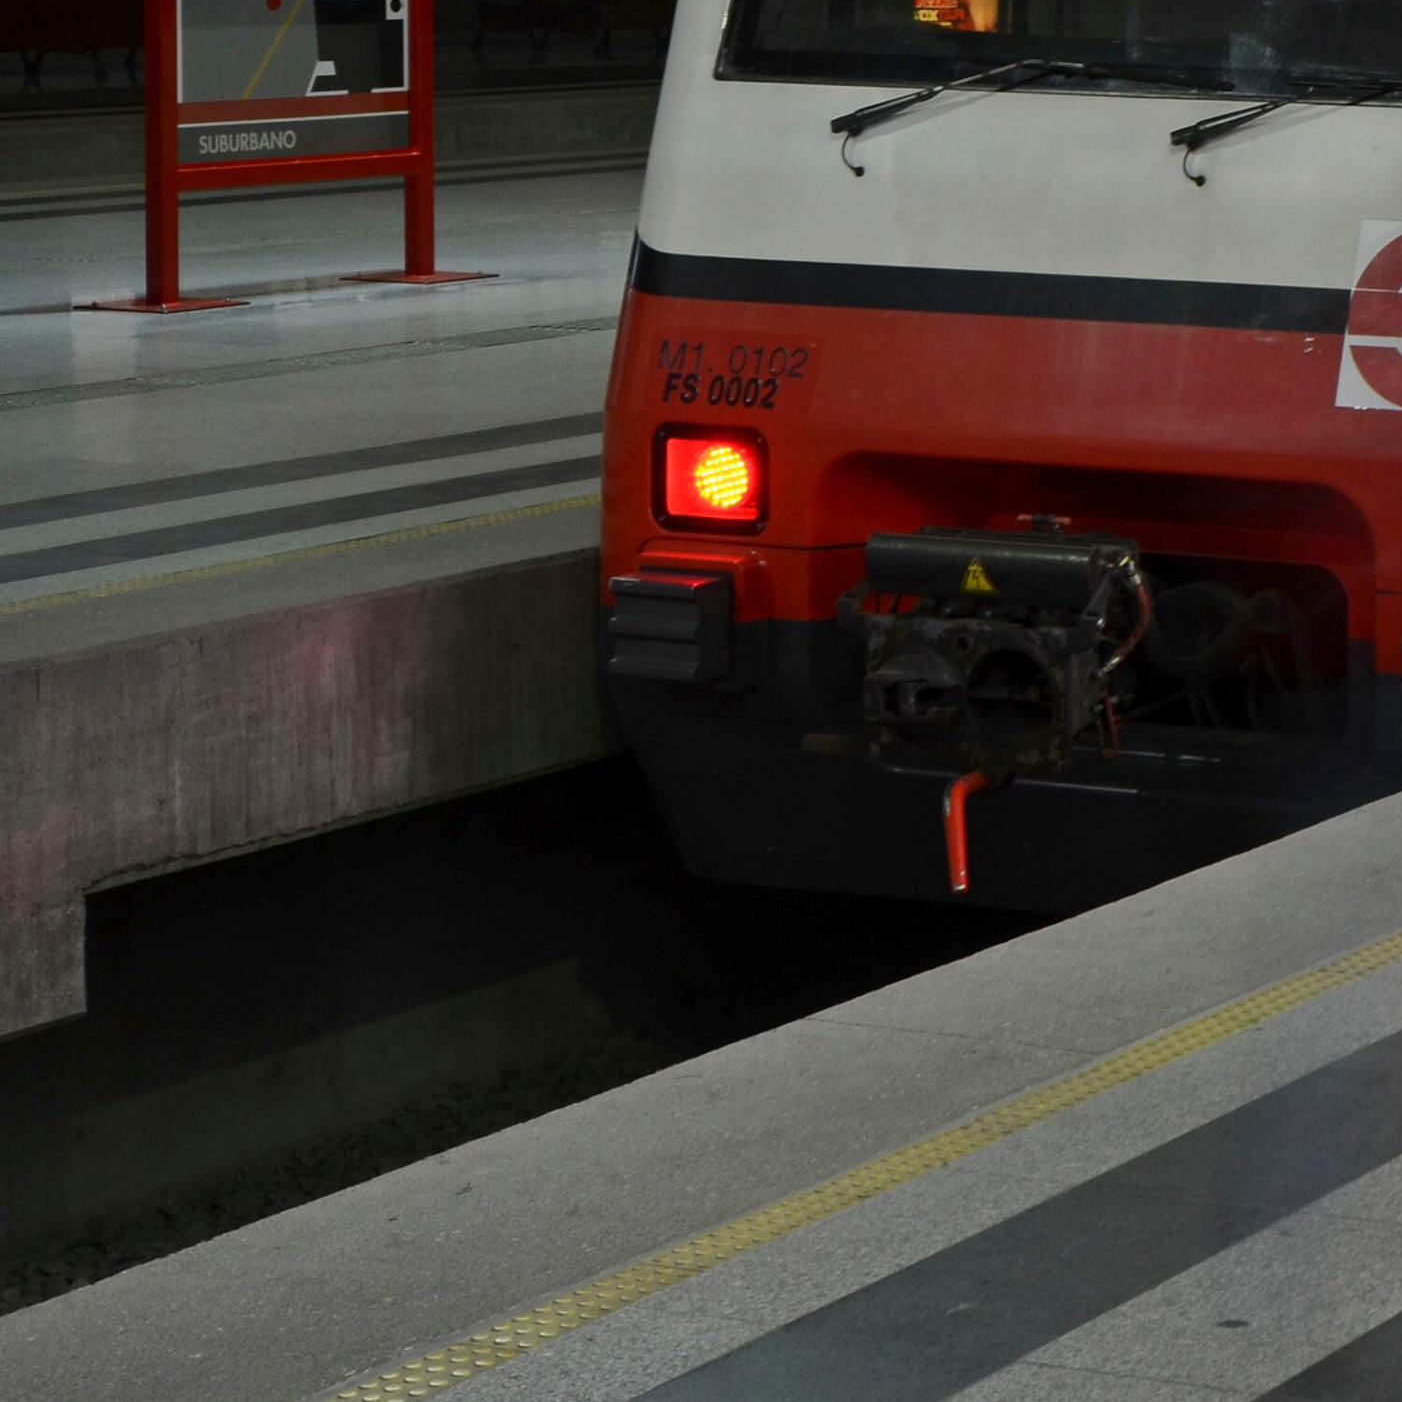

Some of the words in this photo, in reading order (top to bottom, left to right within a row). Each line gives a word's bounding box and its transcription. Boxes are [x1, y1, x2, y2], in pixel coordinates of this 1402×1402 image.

[199, 130, 296, 154] SUBURBANO
[657, 339, 713, 373] M1.
[728, 344, 810, 378] 0102
[661, 372, 700, 404] FS
[708, 375, 779, 409] 0002
